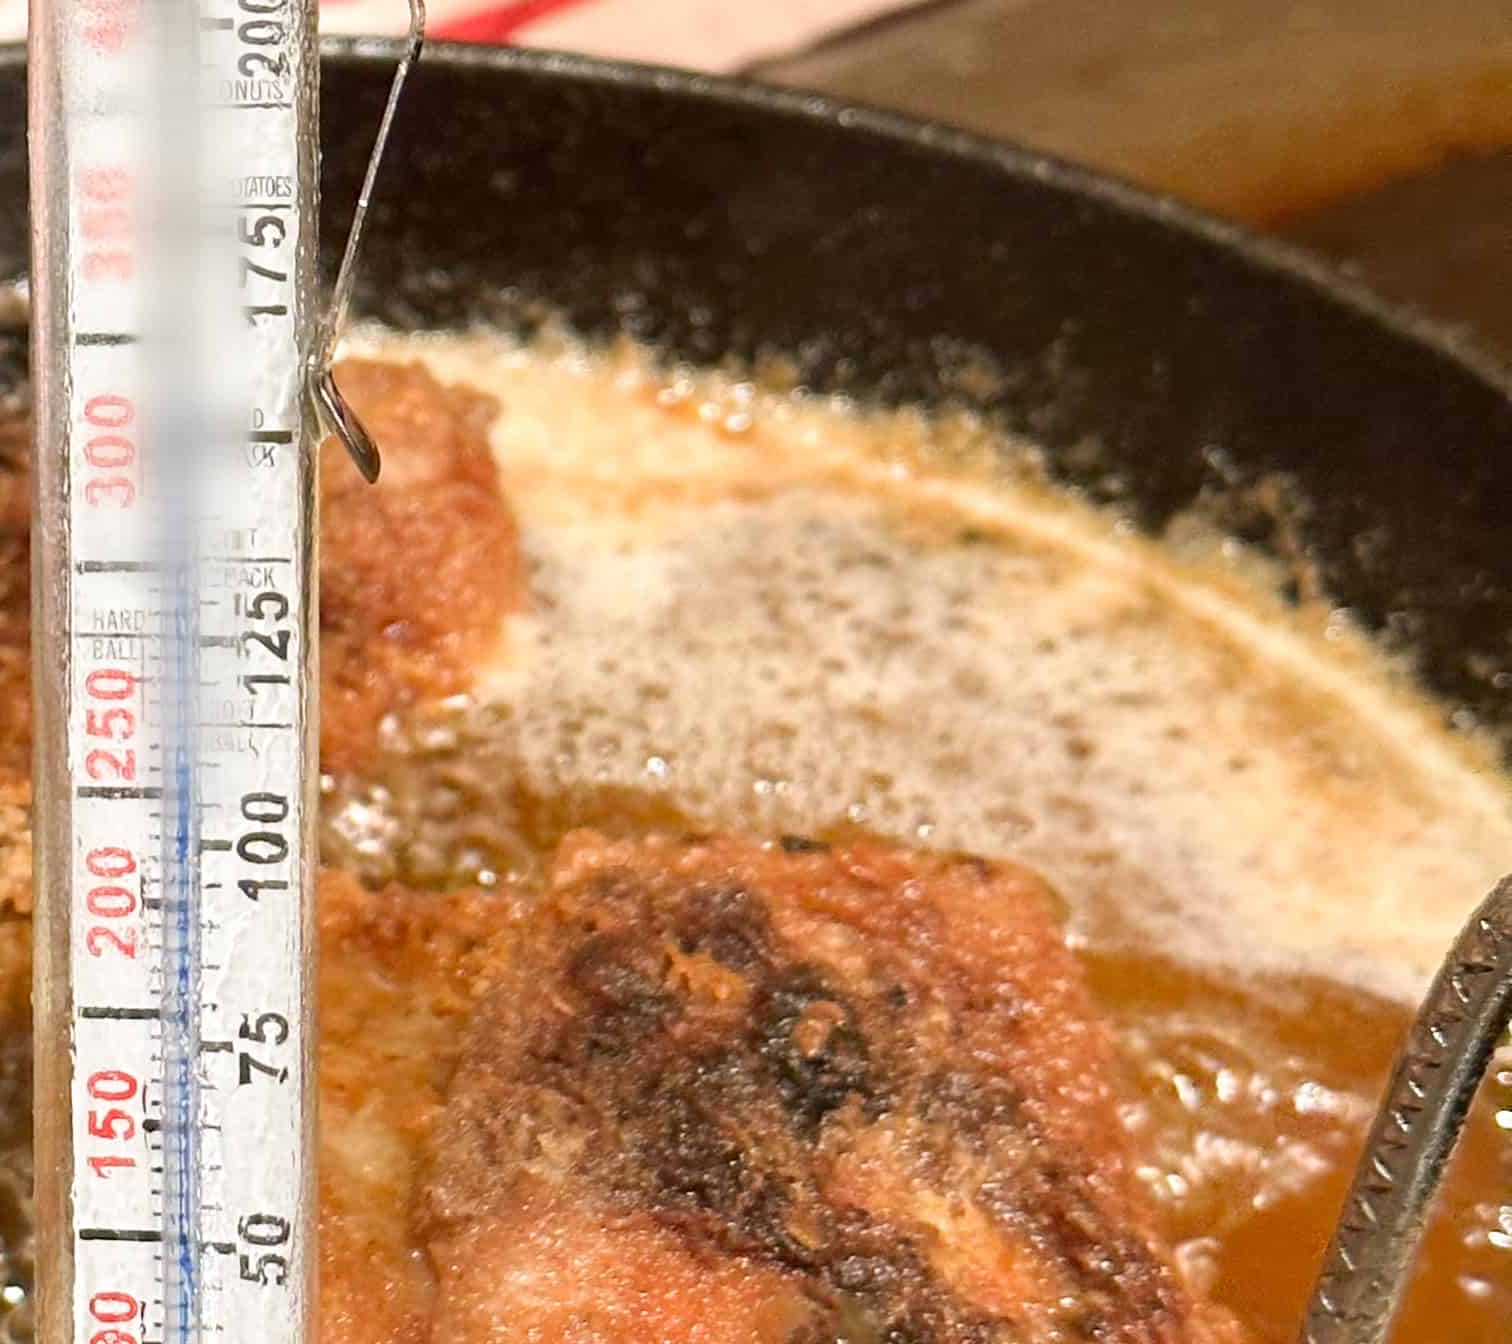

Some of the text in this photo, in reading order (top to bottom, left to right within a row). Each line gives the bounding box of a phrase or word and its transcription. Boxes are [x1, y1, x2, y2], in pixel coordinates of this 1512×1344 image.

[239, 216, 287, 327] 175
[84, 395, 136, 508] 300
[236, 591, 290, 695] 125
[85, 668, 137, 781] 250
[237, 792, 289, 901] 100
[86, 846, 137, 959] 200
[239, 1012, 289, 1085] 75
[87, 1069, 138, 1179] 150
[238, 1212, 290, 1286] 50
